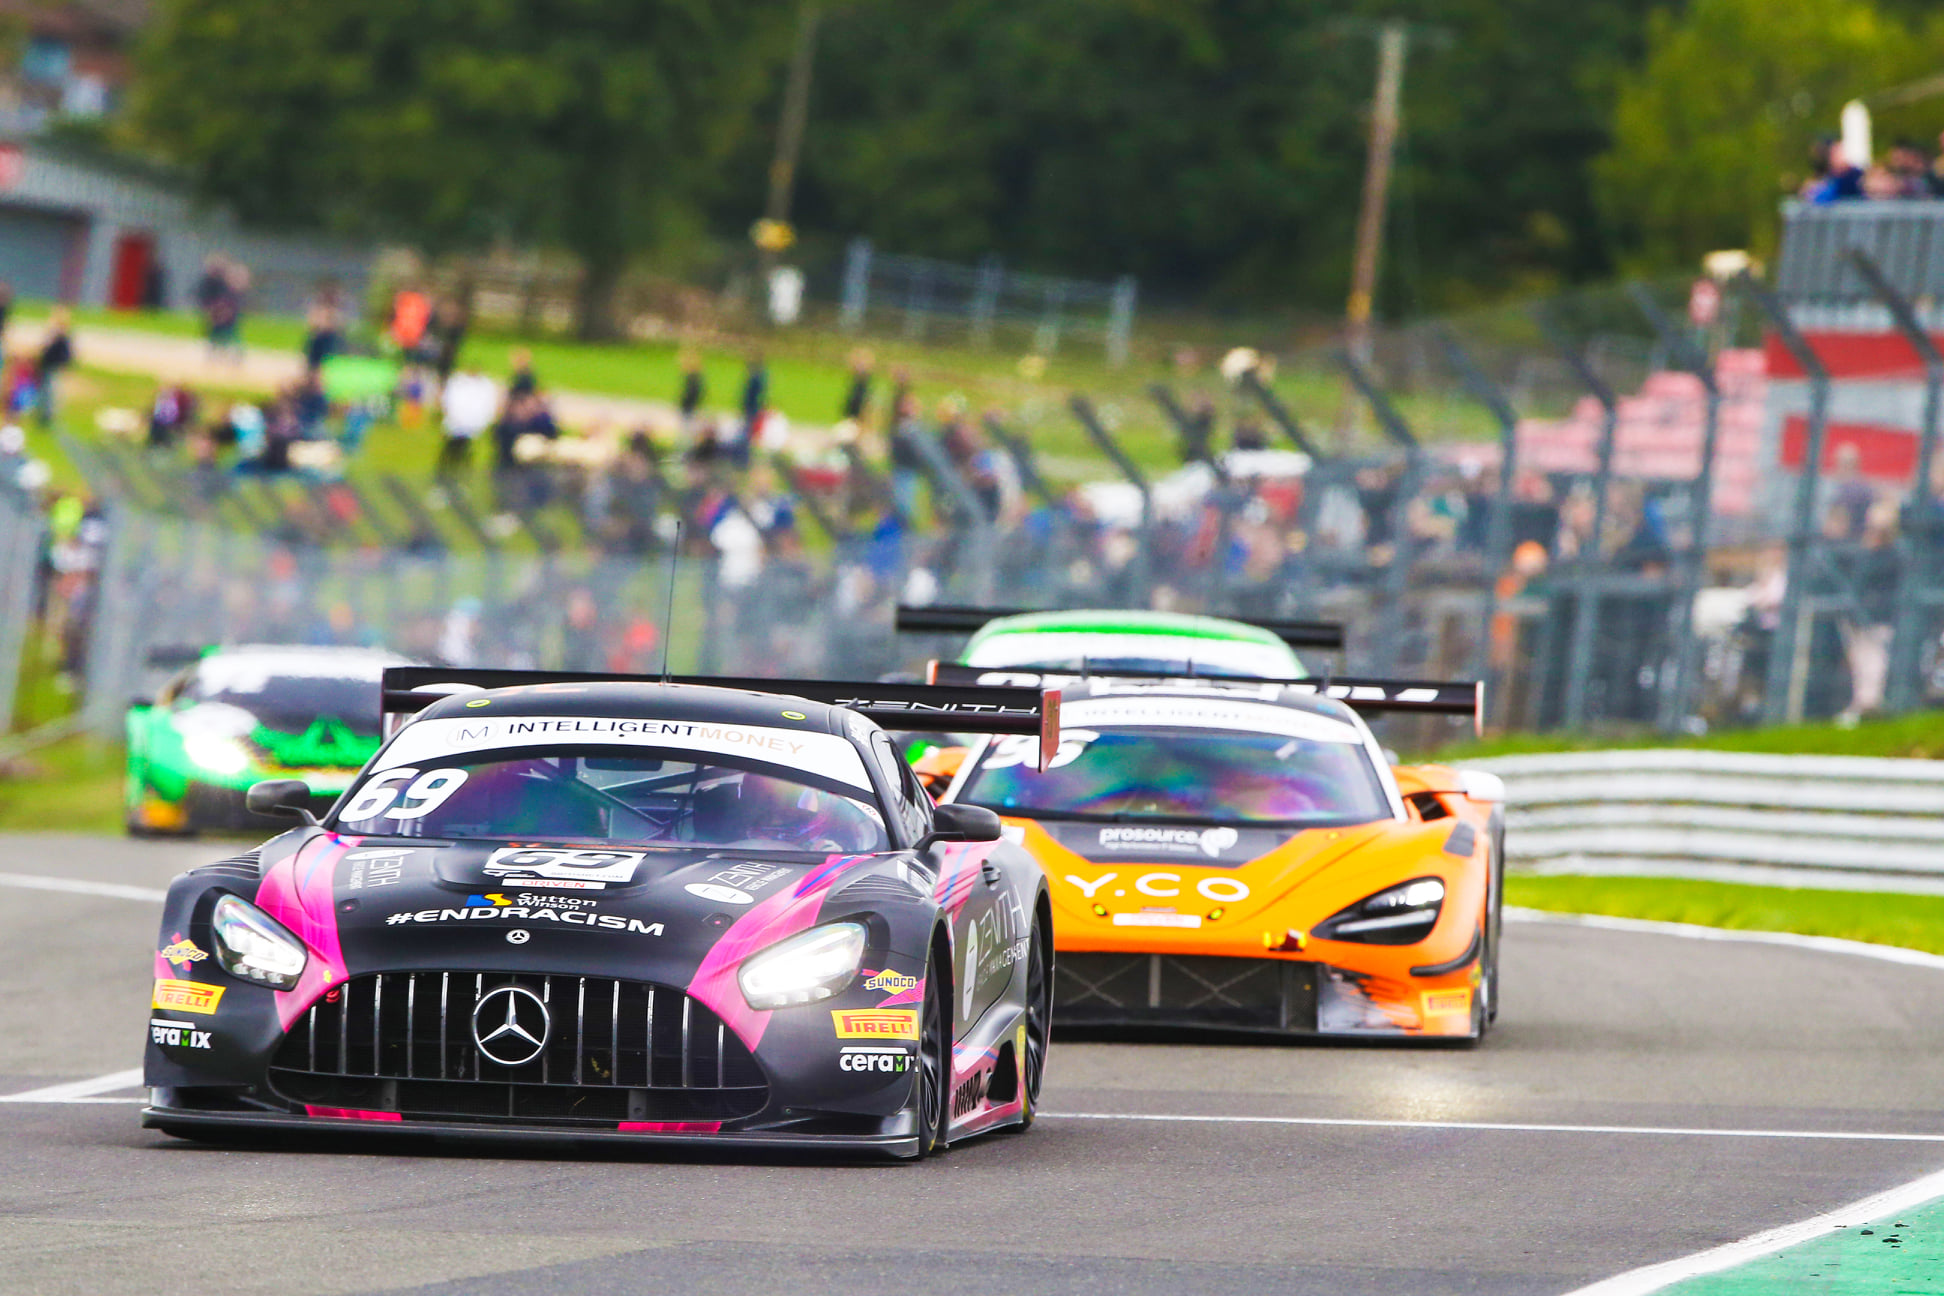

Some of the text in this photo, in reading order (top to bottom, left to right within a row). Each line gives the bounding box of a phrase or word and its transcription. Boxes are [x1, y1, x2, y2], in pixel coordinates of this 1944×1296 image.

[338, 767, 469, 822] 69
[496, 850, 634, 869] 69
[521, 879, 587, 889] DRIVEN
[706, 861, 777, 888] ZENITH
[516, 898, 580, 911] Winson
[518, 892, 598, 908] Sutton
[385, 906, 666, 938] #ENDRACISM
[978, 884, 1028, 967] ZENITH
[868, 976, 915, 989] SUNOCO
[155, 984, 215, 1008] PIRELLI
[841, 1014, 914, 1035] PIRELLI
